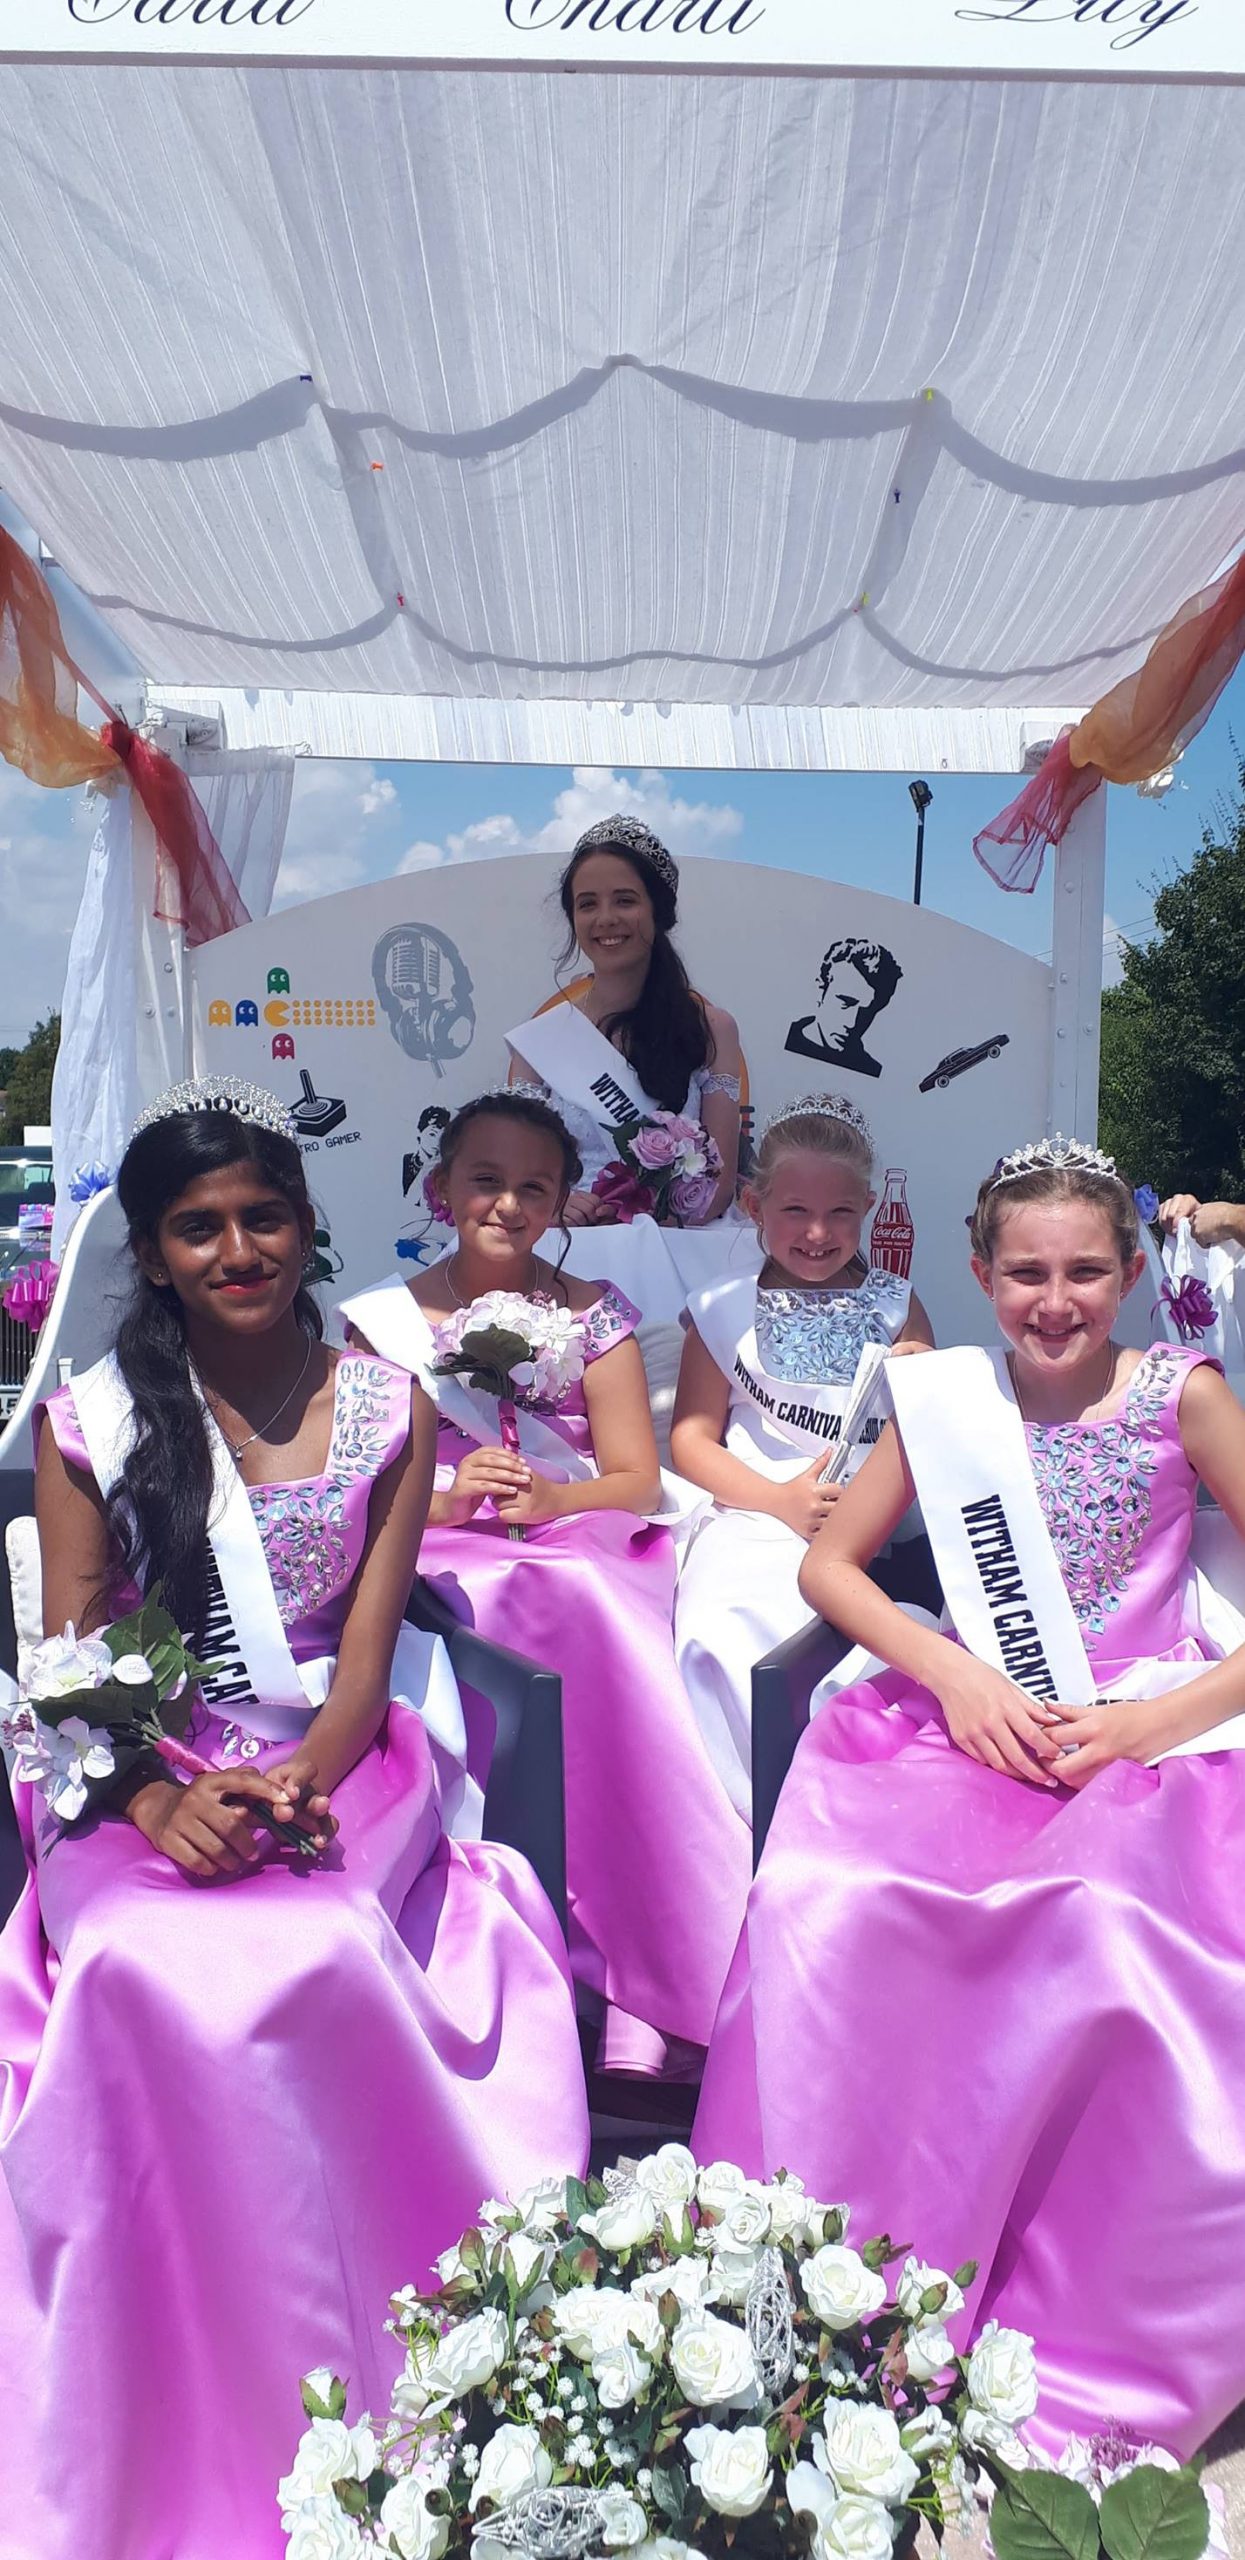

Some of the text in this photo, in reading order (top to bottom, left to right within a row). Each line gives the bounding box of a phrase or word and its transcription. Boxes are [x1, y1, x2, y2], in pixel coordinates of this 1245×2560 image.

[325, 1131, 362, 1148] GAMER
[733, 1353, 776, 1413] WITHAM
[960, 1494, 1028, 1608] WITHAM
